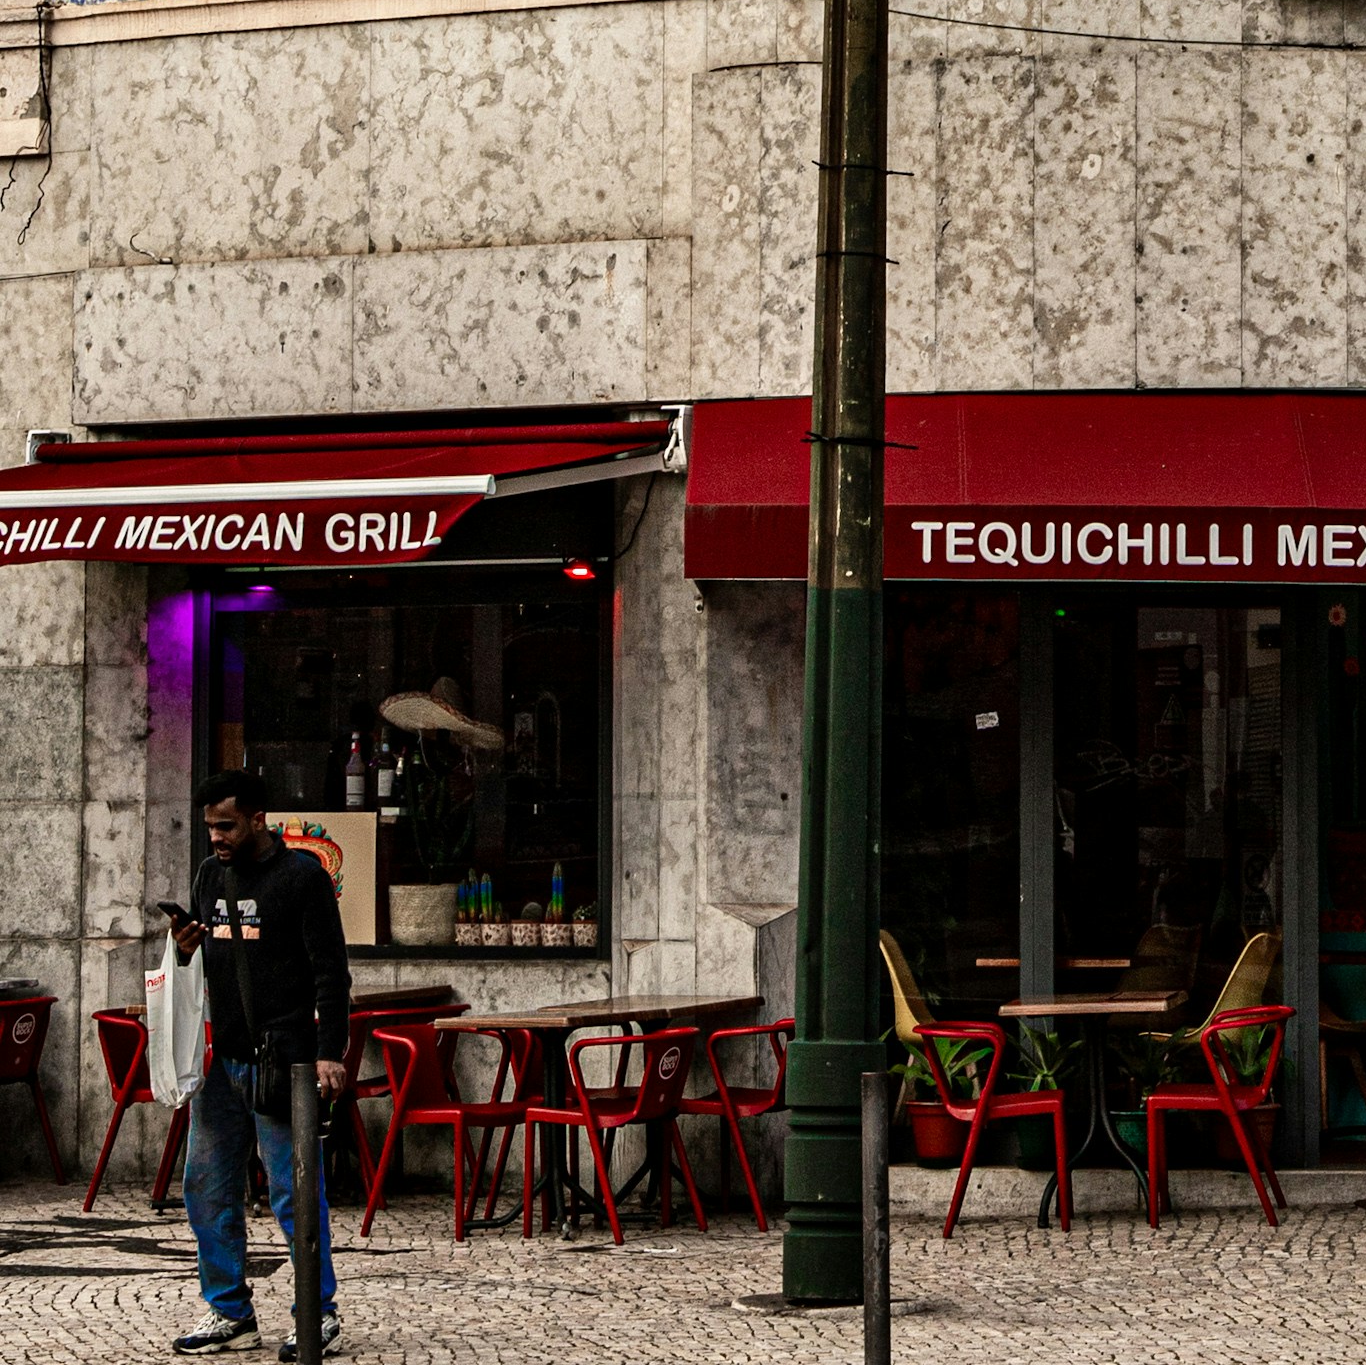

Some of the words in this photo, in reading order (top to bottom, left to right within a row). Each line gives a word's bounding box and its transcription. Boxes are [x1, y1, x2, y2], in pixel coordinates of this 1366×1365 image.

[114, 512, 305, 552] MEXICAN
[325, 511, 442, 553] GRILL
[910, 521, 1253, 566] TEQUICHILLI
